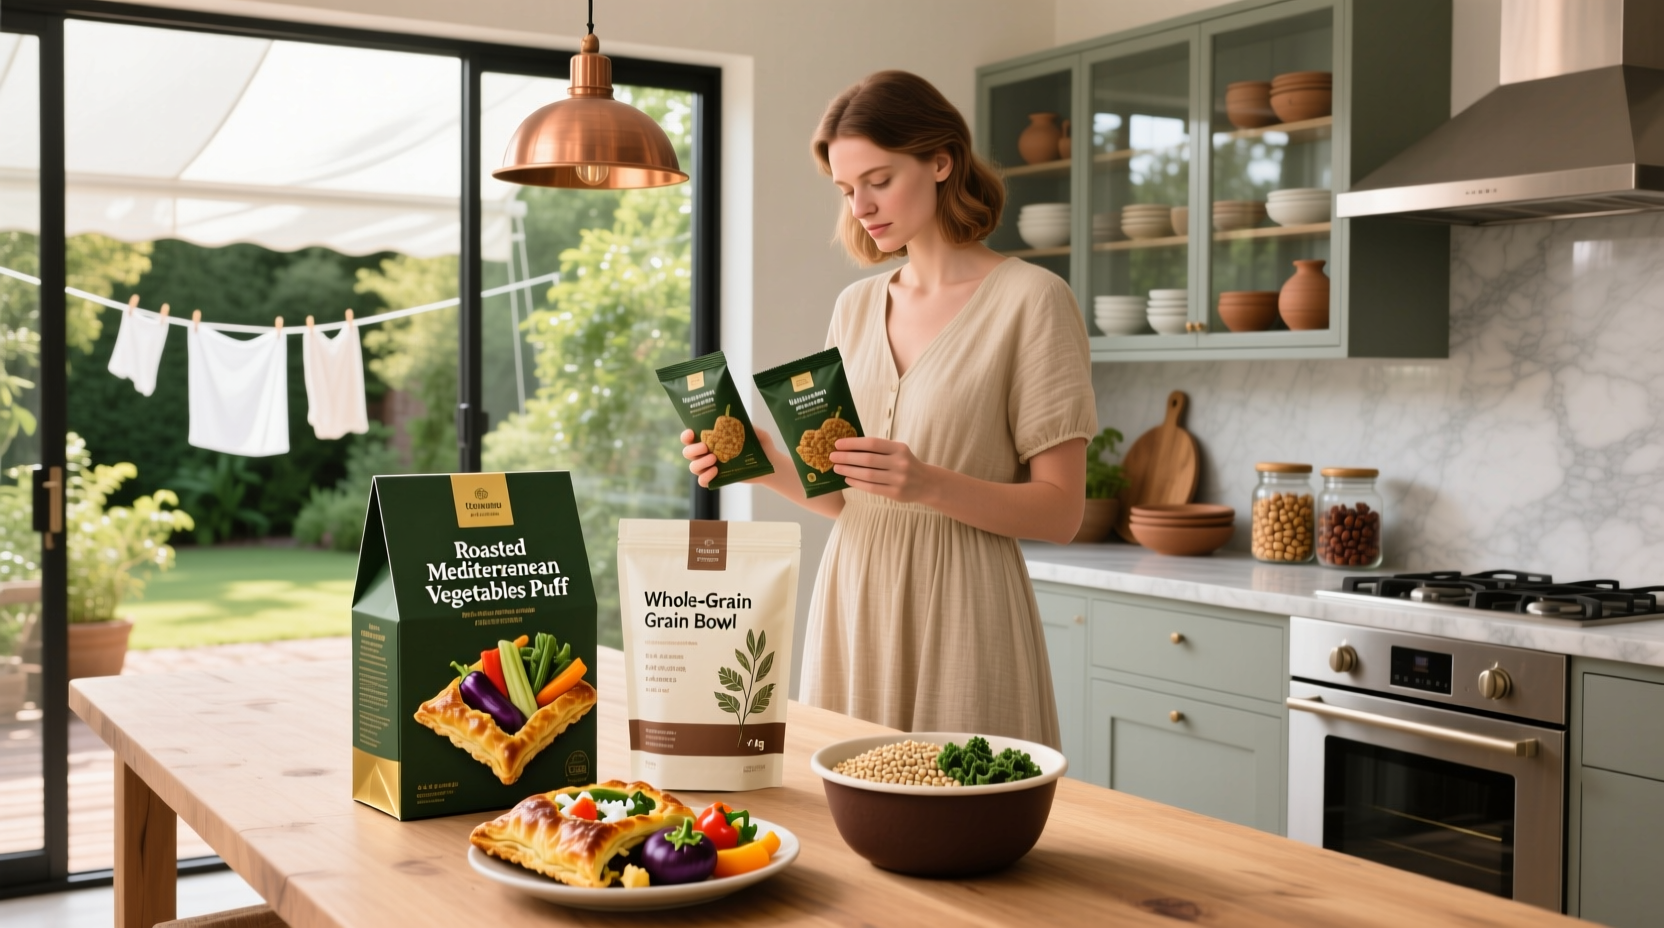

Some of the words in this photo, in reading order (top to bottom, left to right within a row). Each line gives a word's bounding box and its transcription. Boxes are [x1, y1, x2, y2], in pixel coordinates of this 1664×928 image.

[453, 538, 527, 559] Roasted
[425, 581, 527, 609] Vegetables
[529, 577, 569, 598] Puff
[644, 591, 752, 609] Whole-Grain
[644, 612, 689, 629] Grain
[694, 613, 737, 630] Bowl
